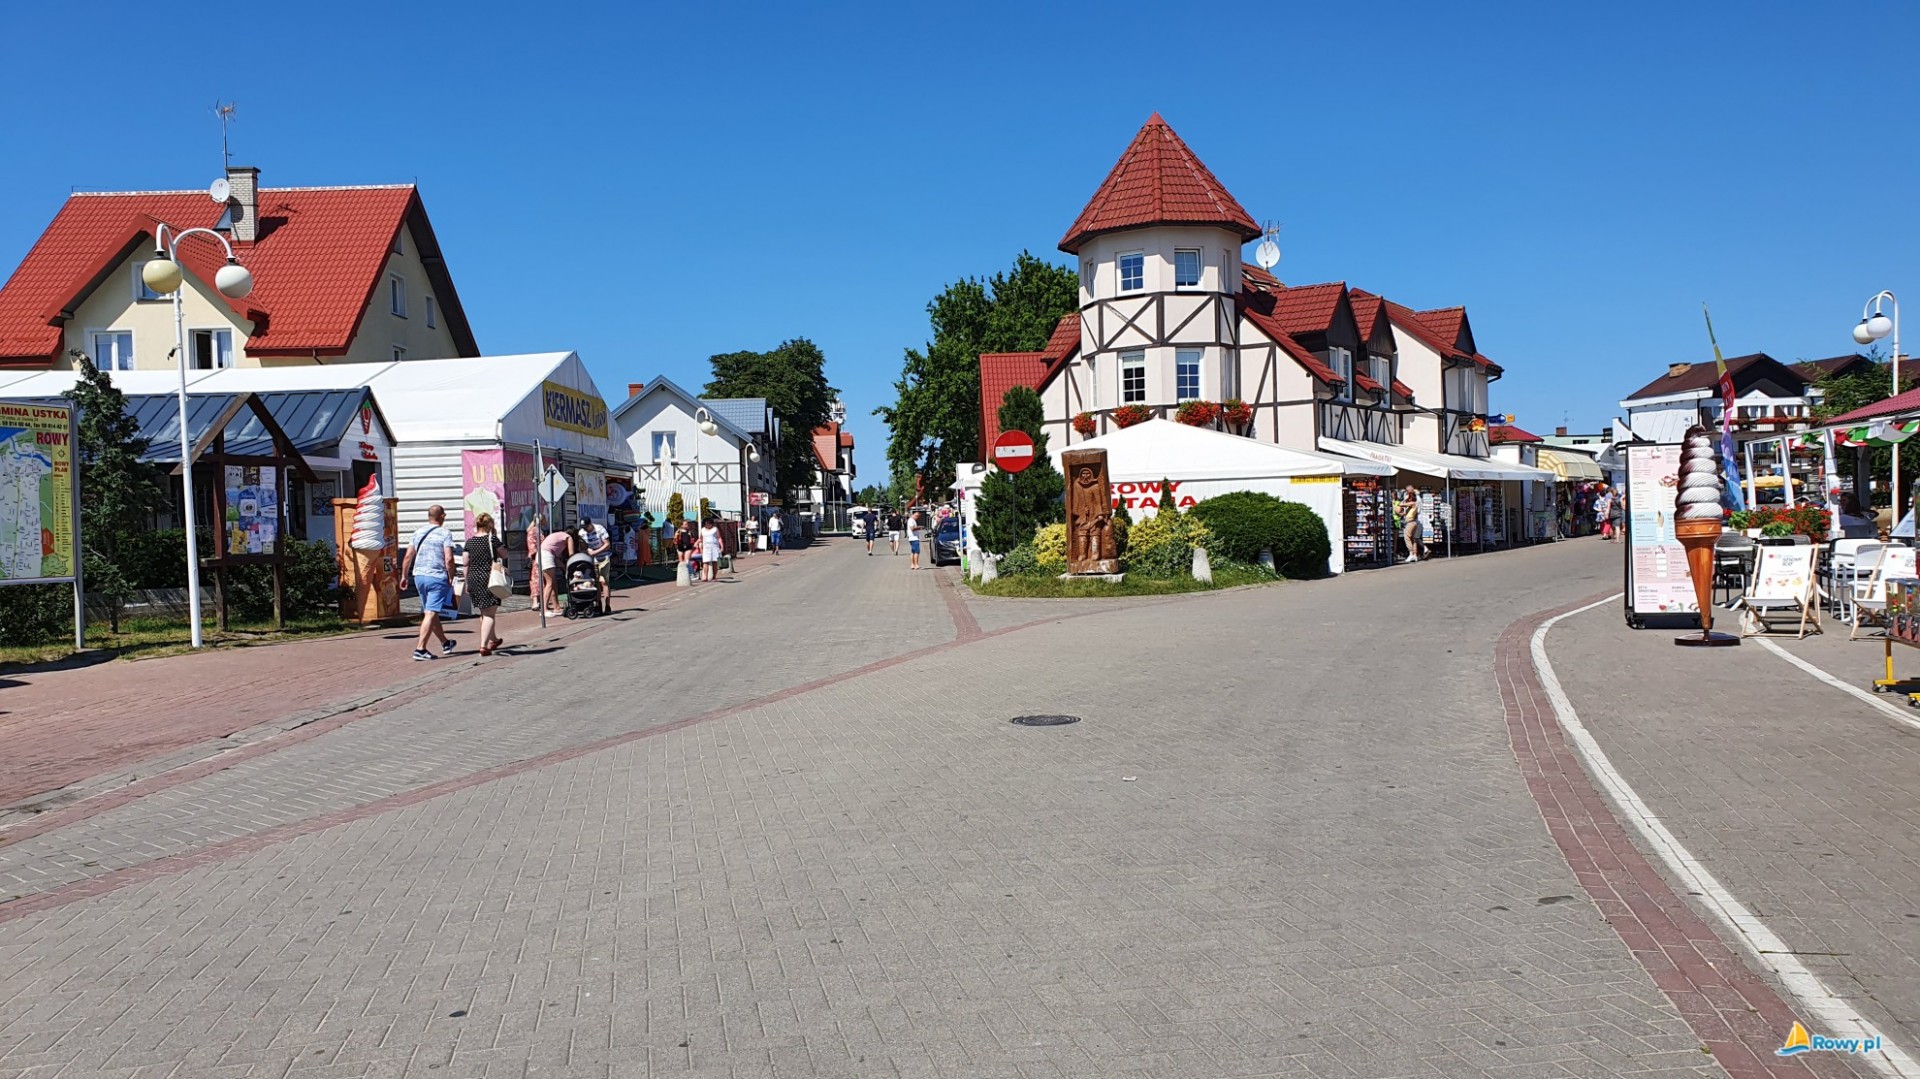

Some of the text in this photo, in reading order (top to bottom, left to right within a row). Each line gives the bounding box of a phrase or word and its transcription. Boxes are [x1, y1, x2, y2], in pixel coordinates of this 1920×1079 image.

[0, 407, 29, 416] MINA
[32, 409, 67, 419] USTKA
[546, 390, 591, 428] KIERMASZ
[36, 432, 69, 446] ROWY
[472, 464, 485, 484] U
